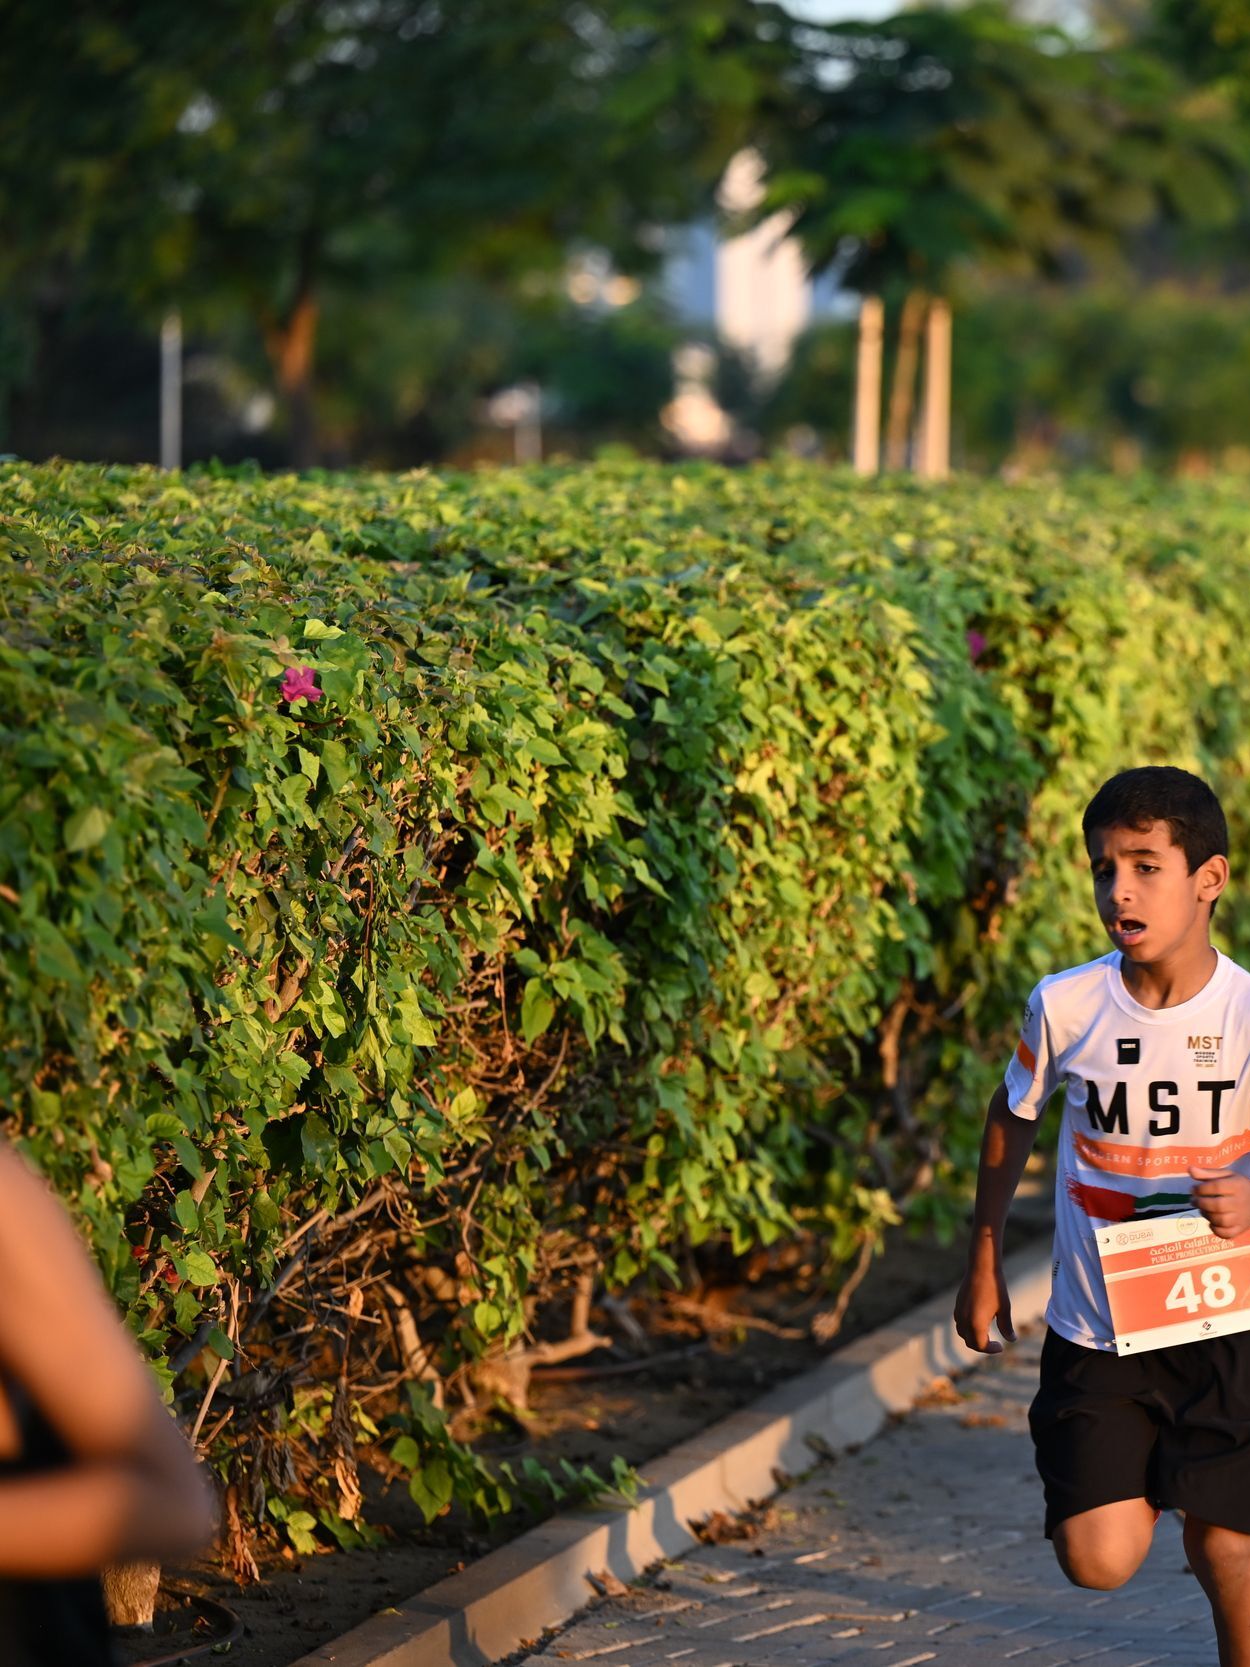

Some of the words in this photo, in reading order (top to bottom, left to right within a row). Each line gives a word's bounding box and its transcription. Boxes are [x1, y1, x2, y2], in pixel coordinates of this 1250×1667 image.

[1187, 1035, 1224, 1050] MST
[1086, 1079, 1237, 1138] MST
[1137, 1156, 1189, 1167] SPORTS
[1151, 1252, 1176, 1265] PUBLIC
[1165, 1265, 1236, 1313] 48
